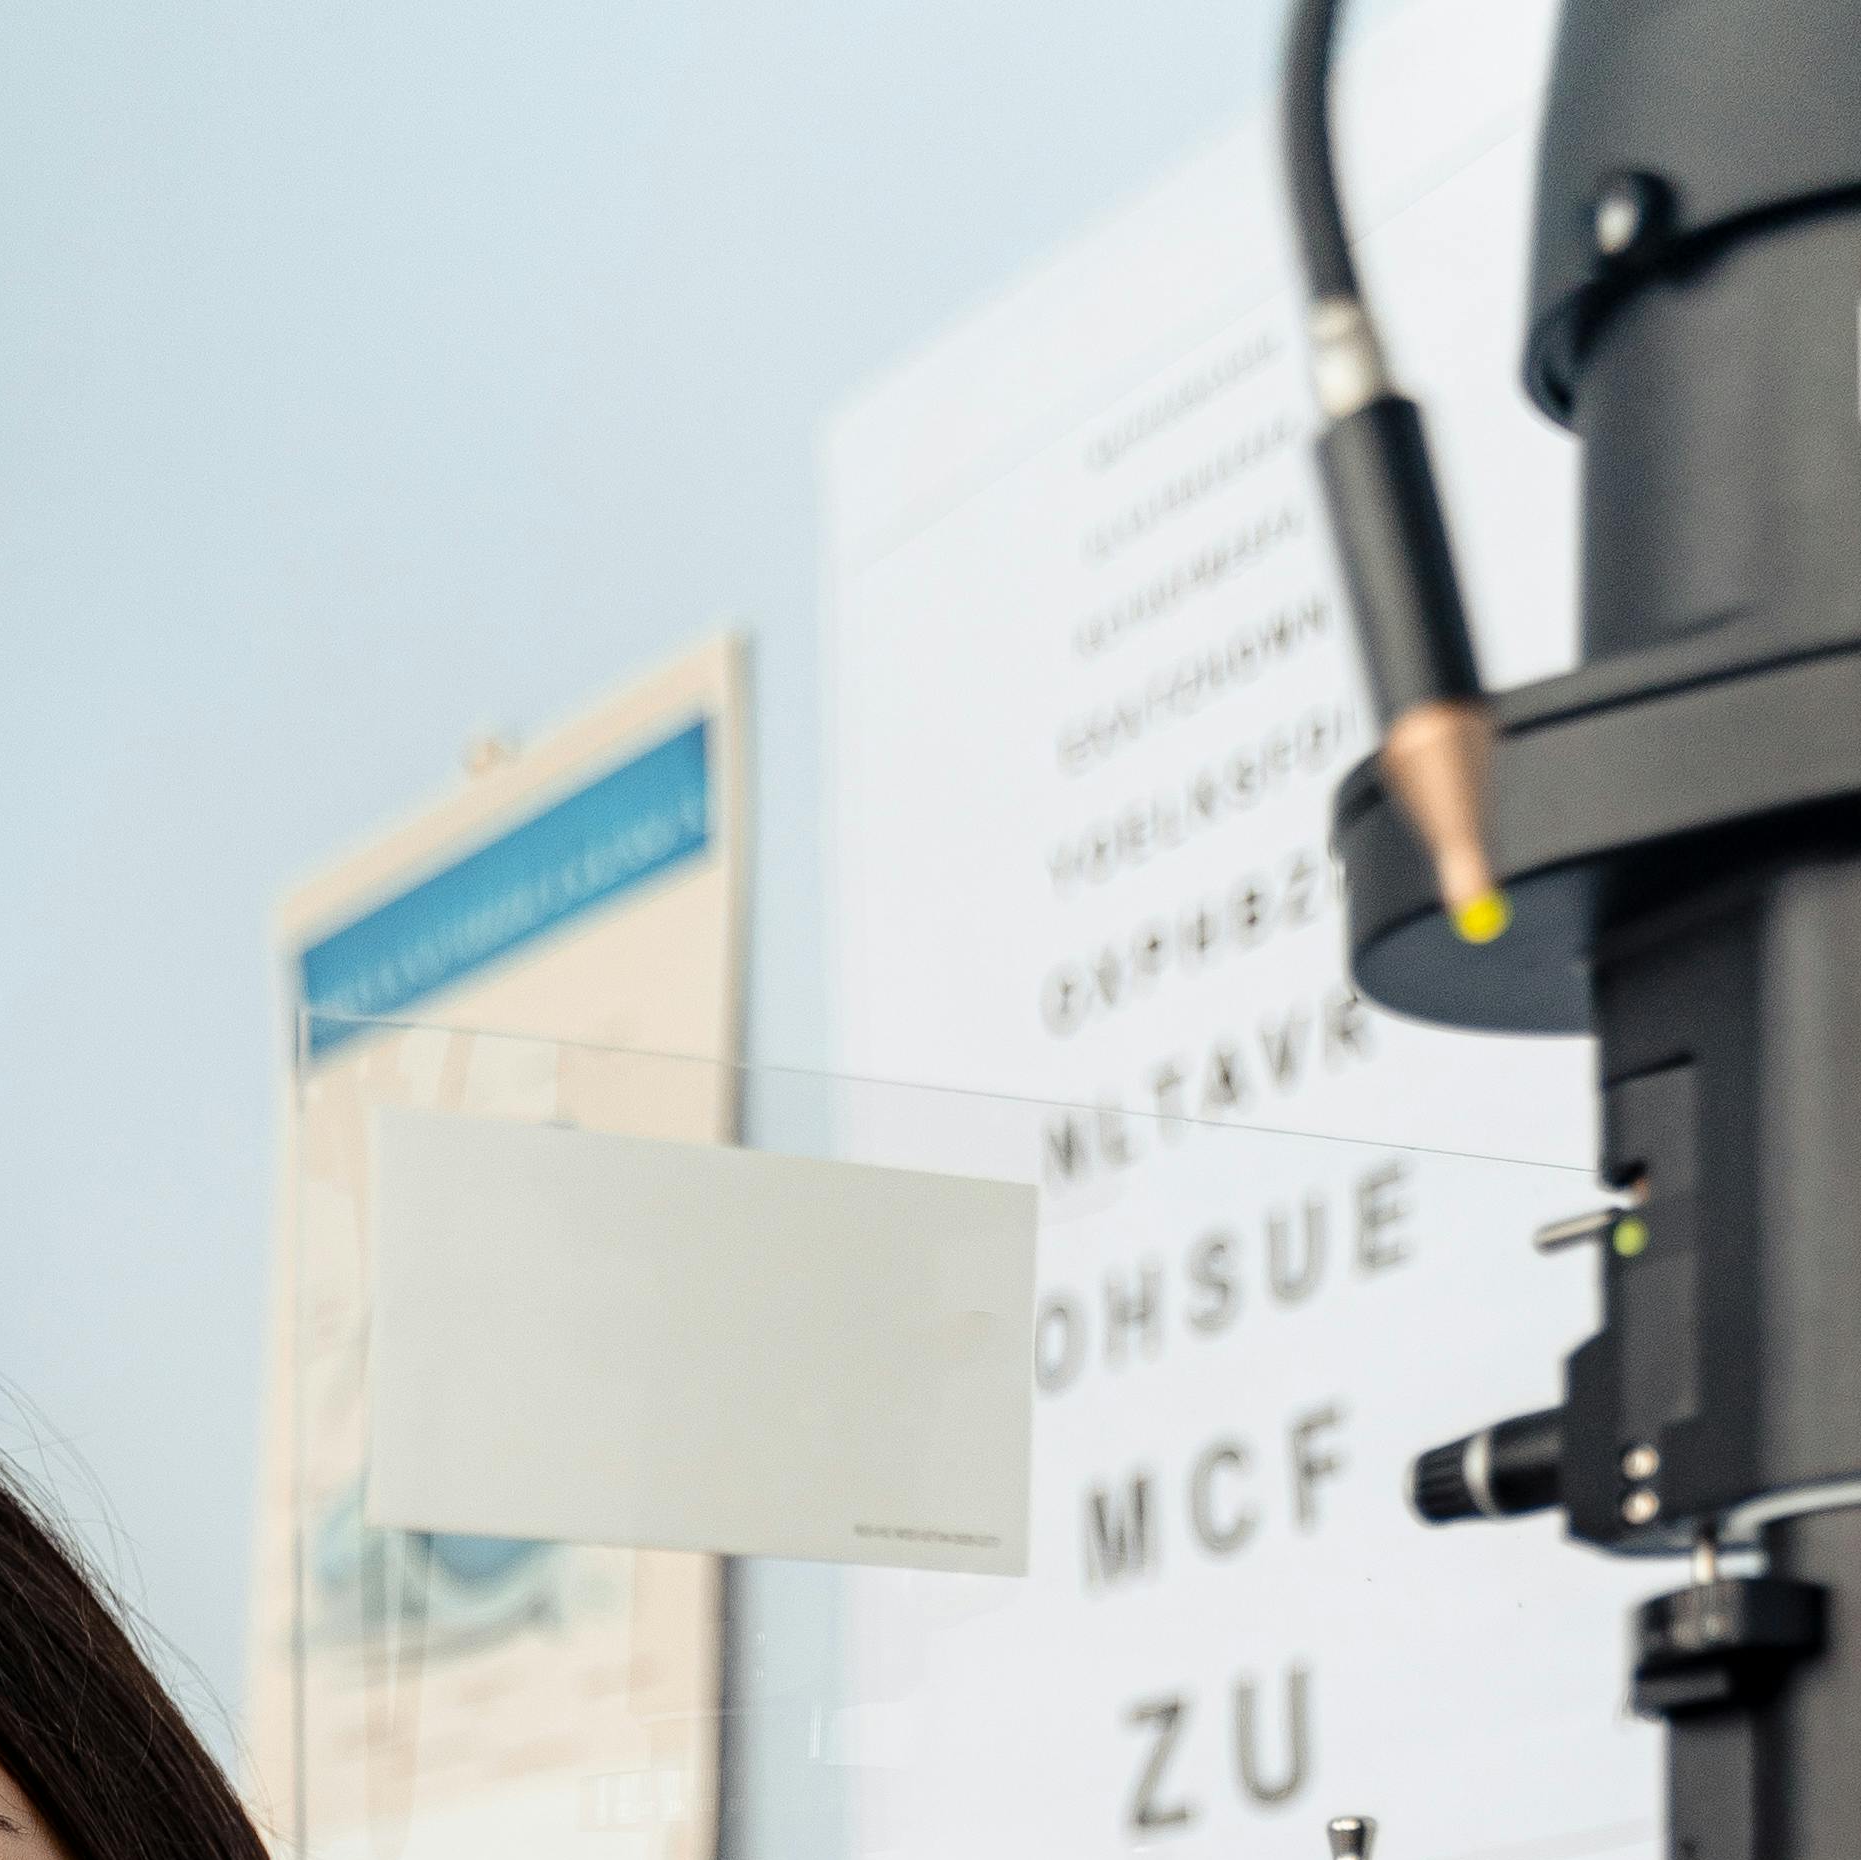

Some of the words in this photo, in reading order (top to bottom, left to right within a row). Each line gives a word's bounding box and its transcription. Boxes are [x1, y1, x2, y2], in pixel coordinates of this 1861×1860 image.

[1036, 1158, 1414, 1392] OHSUE
[1084, 1402, 1352, 1590] MCF
[1125, 1658, 1314, 1834] ZU
